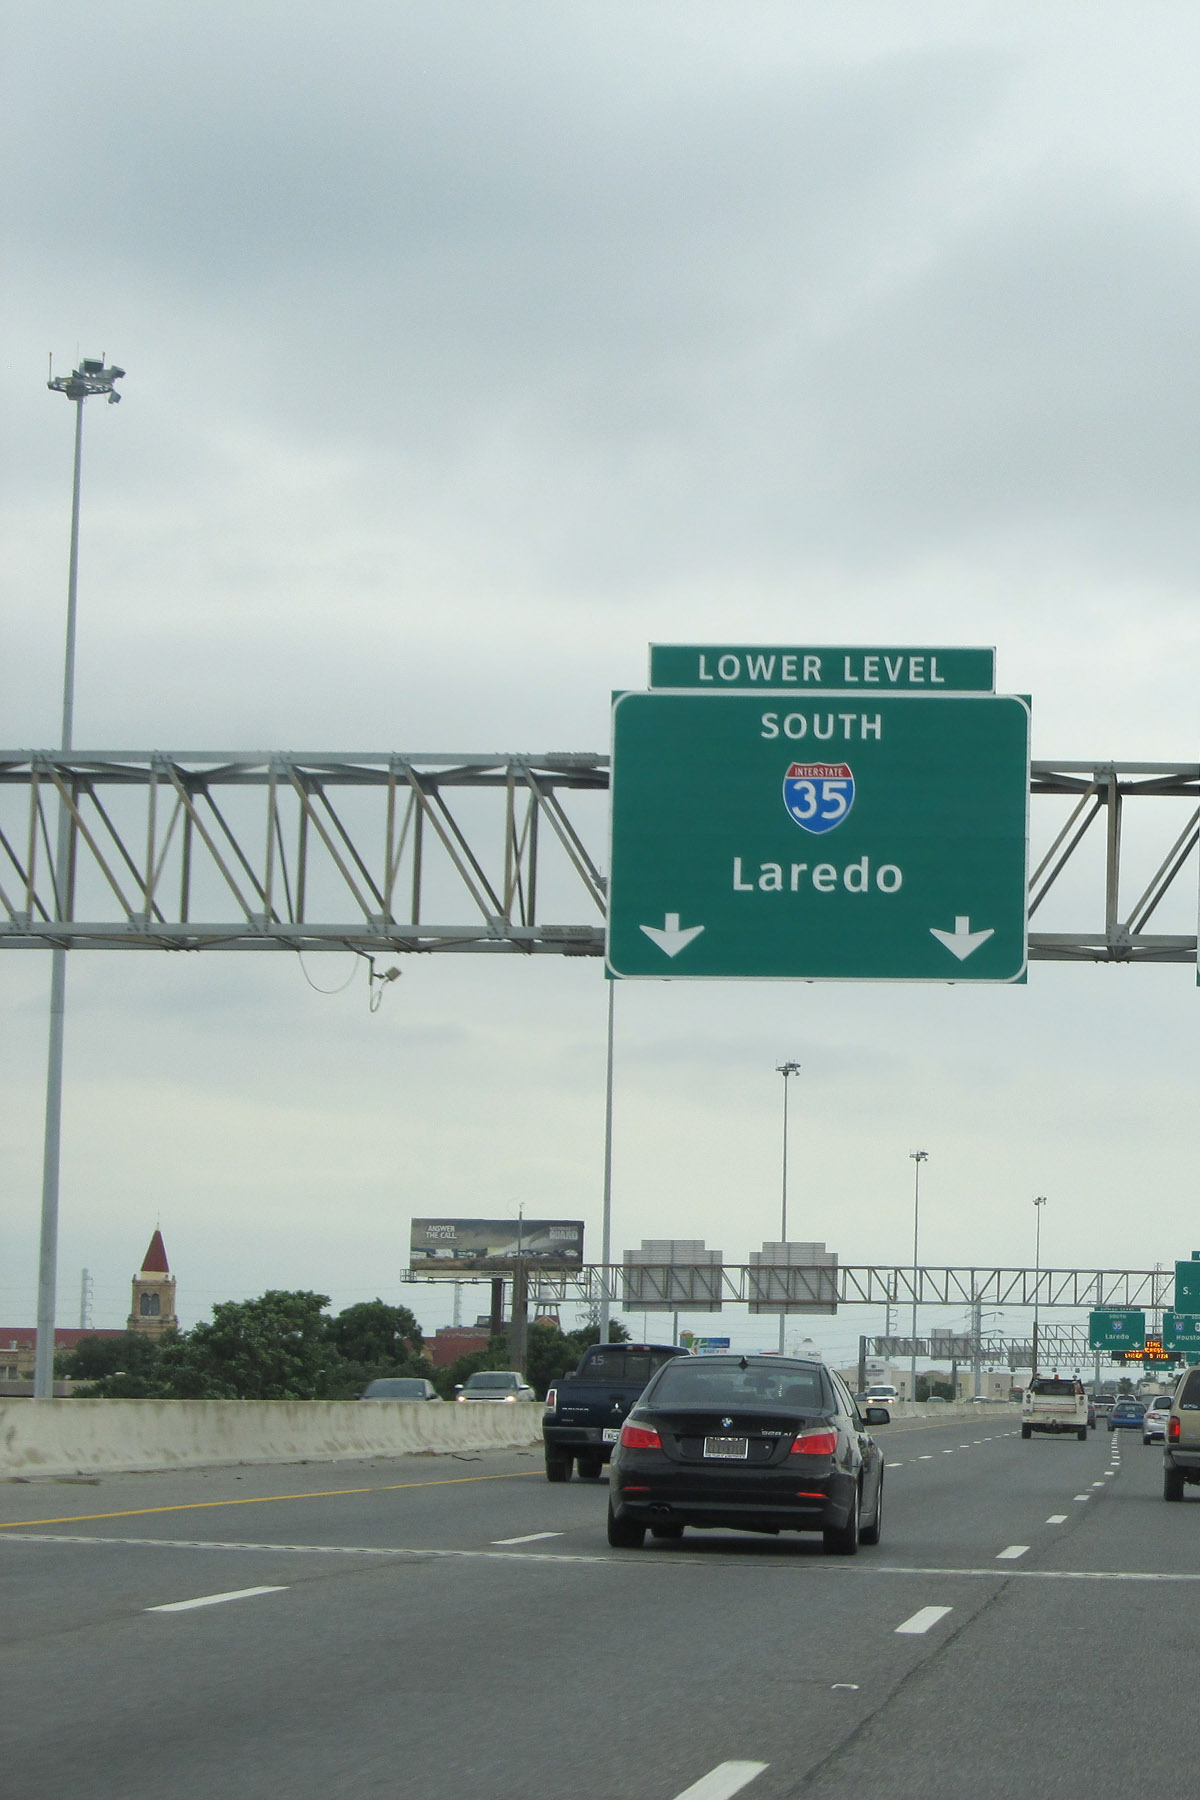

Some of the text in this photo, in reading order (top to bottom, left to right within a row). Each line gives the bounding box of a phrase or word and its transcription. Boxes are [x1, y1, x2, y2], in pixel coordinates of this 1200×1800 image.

[699, 654, 945, 683] LOWER LEVEL
[760, 712, 882, 740] SOUTH
[794, 767, 844, 777] INTERSTATE
[792, 780, 848, 819] 35
[733, 855, 903, 893] Laredo
[426, 1231, 439, 1239] THE
[1182, 1286, 1192, 1295] S.
[590, 1355, 605, 1366] 15
